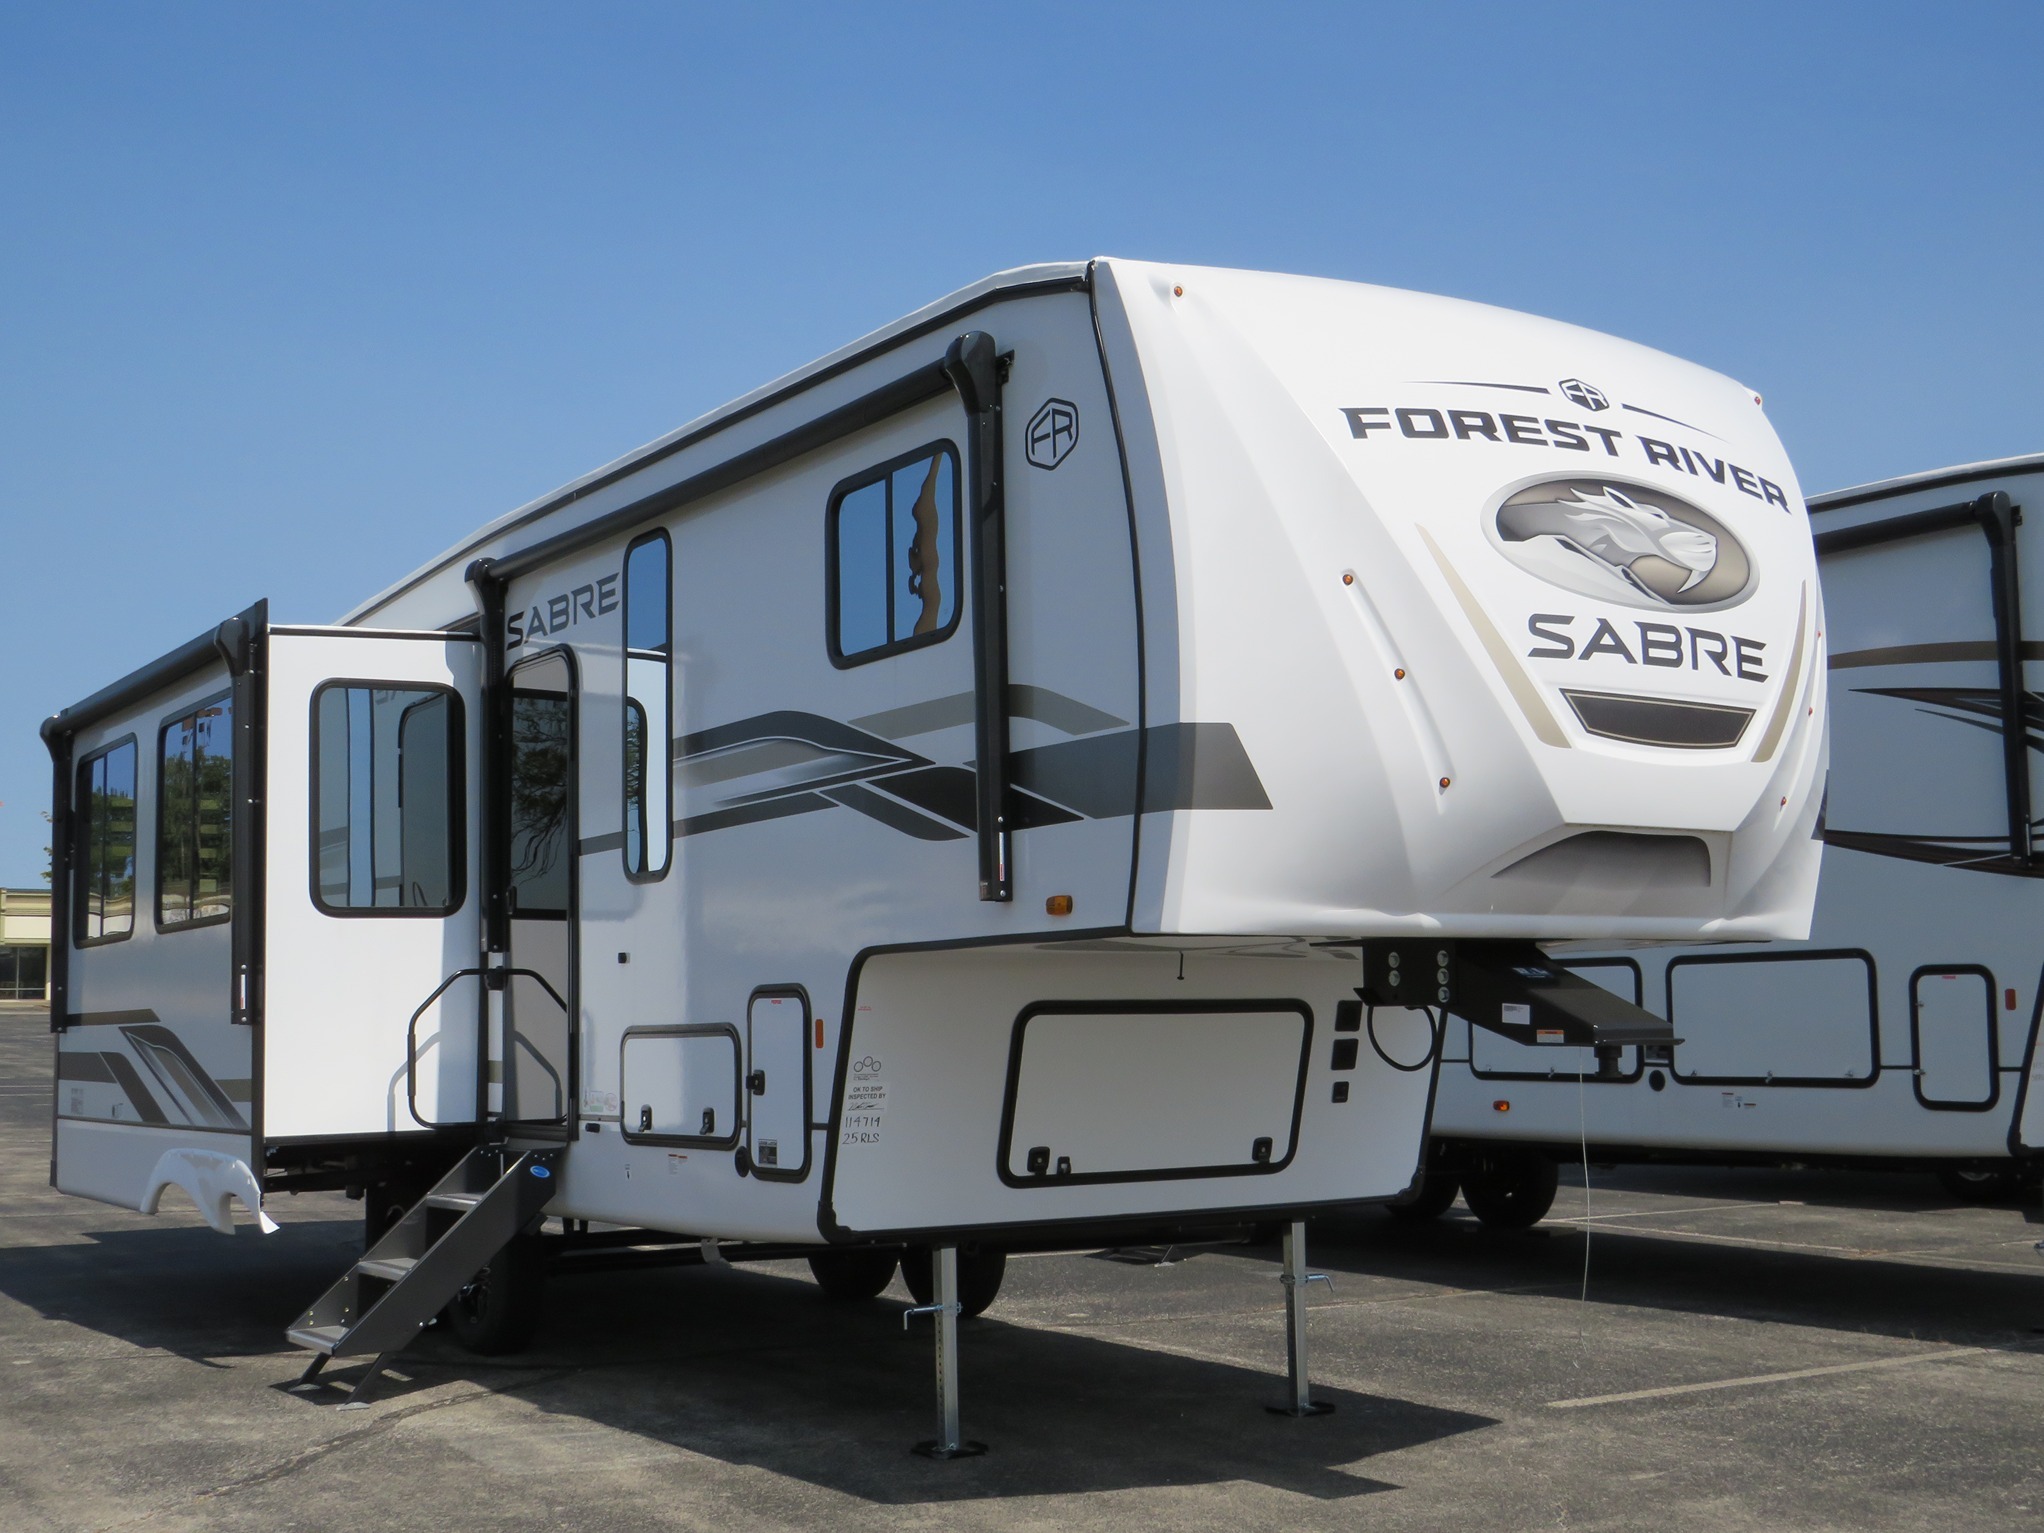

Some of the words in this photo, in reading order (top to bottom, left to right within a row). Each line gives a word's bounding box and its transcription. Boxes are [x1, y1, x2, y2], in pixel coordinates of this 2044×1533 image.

[1338, 407, 1623, 458] FOREST
[1633, 435, 1793, 514] RIVER
[506, 572, 621, 651] SABRE
[1528, 613, 1770, 683] SABRE
